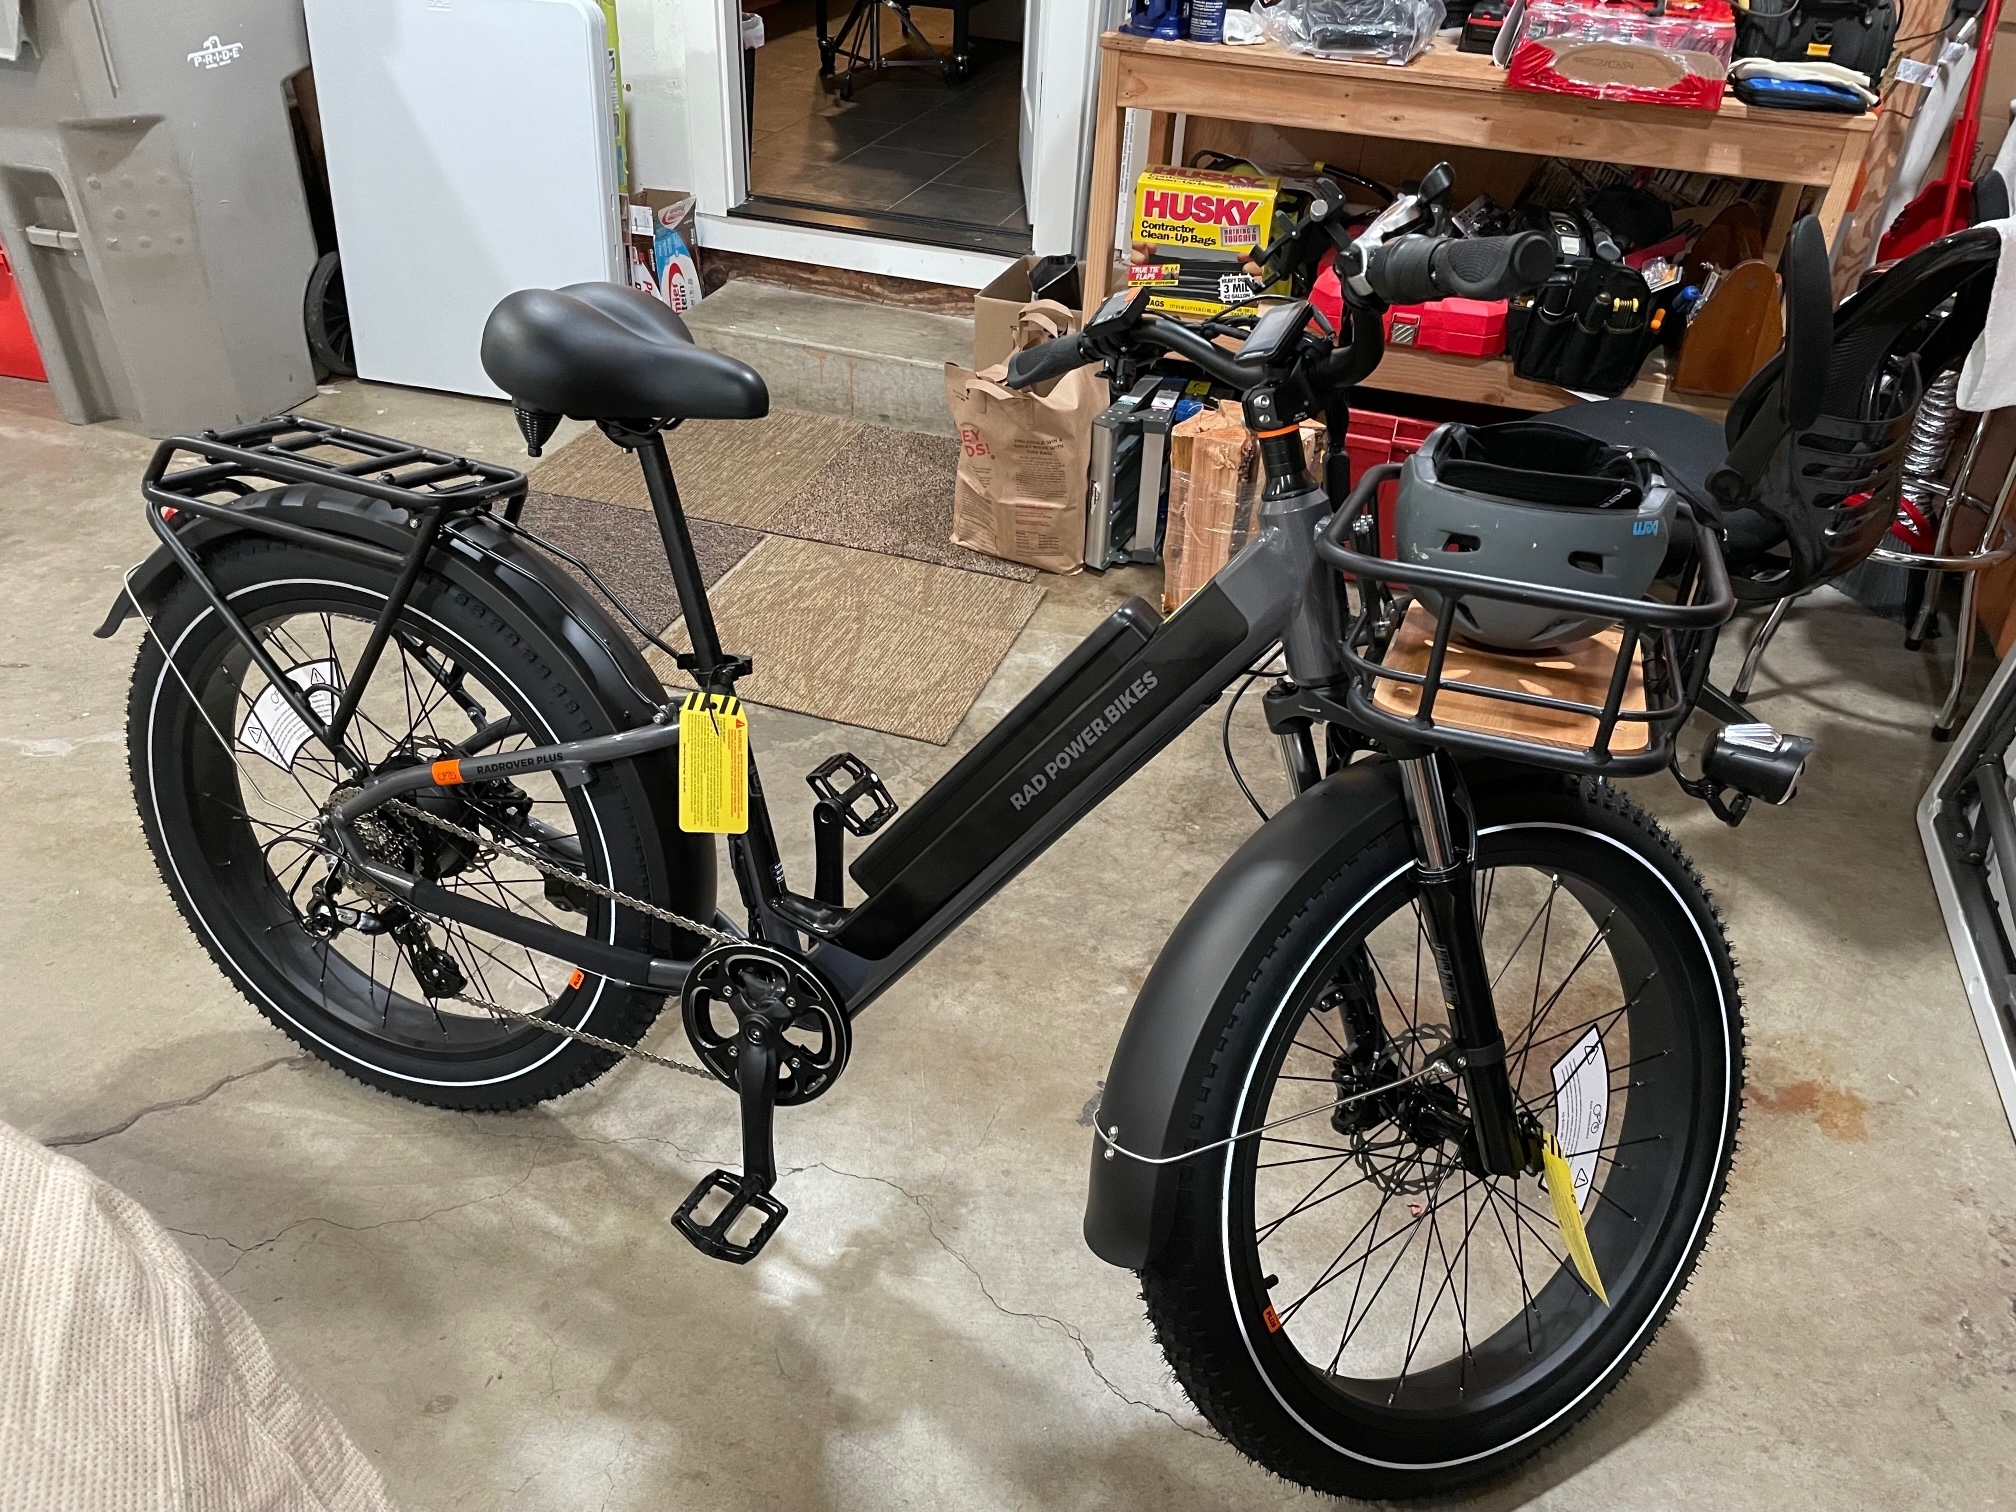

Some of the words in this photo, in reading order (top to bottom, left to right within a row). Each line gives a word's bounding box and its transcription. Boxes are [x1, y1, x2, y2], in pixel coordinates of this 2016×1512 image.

[1153, 167, 1263, 185] HUSKY
[1144, 190, 1260, 227] HUSKY
[1141, 220, 1195, 234] Contractor
[1191, 235, 1217, 246] Bags
[1224, 234, 1257, 243] TOUGHER
[1131, 266, 1148, 274] TRUE
[1223, 284, 1230, 293] 3
[1232, 283, 1250, 293] MIL
[672, 283, 683, 314] mier
[679, 284, 688, 311] tein
[1148, 299, 1165, 308] AGS
[961, 429, 980, 443] EY
[965, 443, 991, 458] DS!
[1009, 773, 1047, 811] RAD
[1044, 717, 1109, 780] POWER
[1103, 670, 1158, 724] BIKES
[476, 757, 535, 775] RADROVER
[536, 752, 564, 765] PLUS
[1265, 1310, 1278, 1329] PLUS
